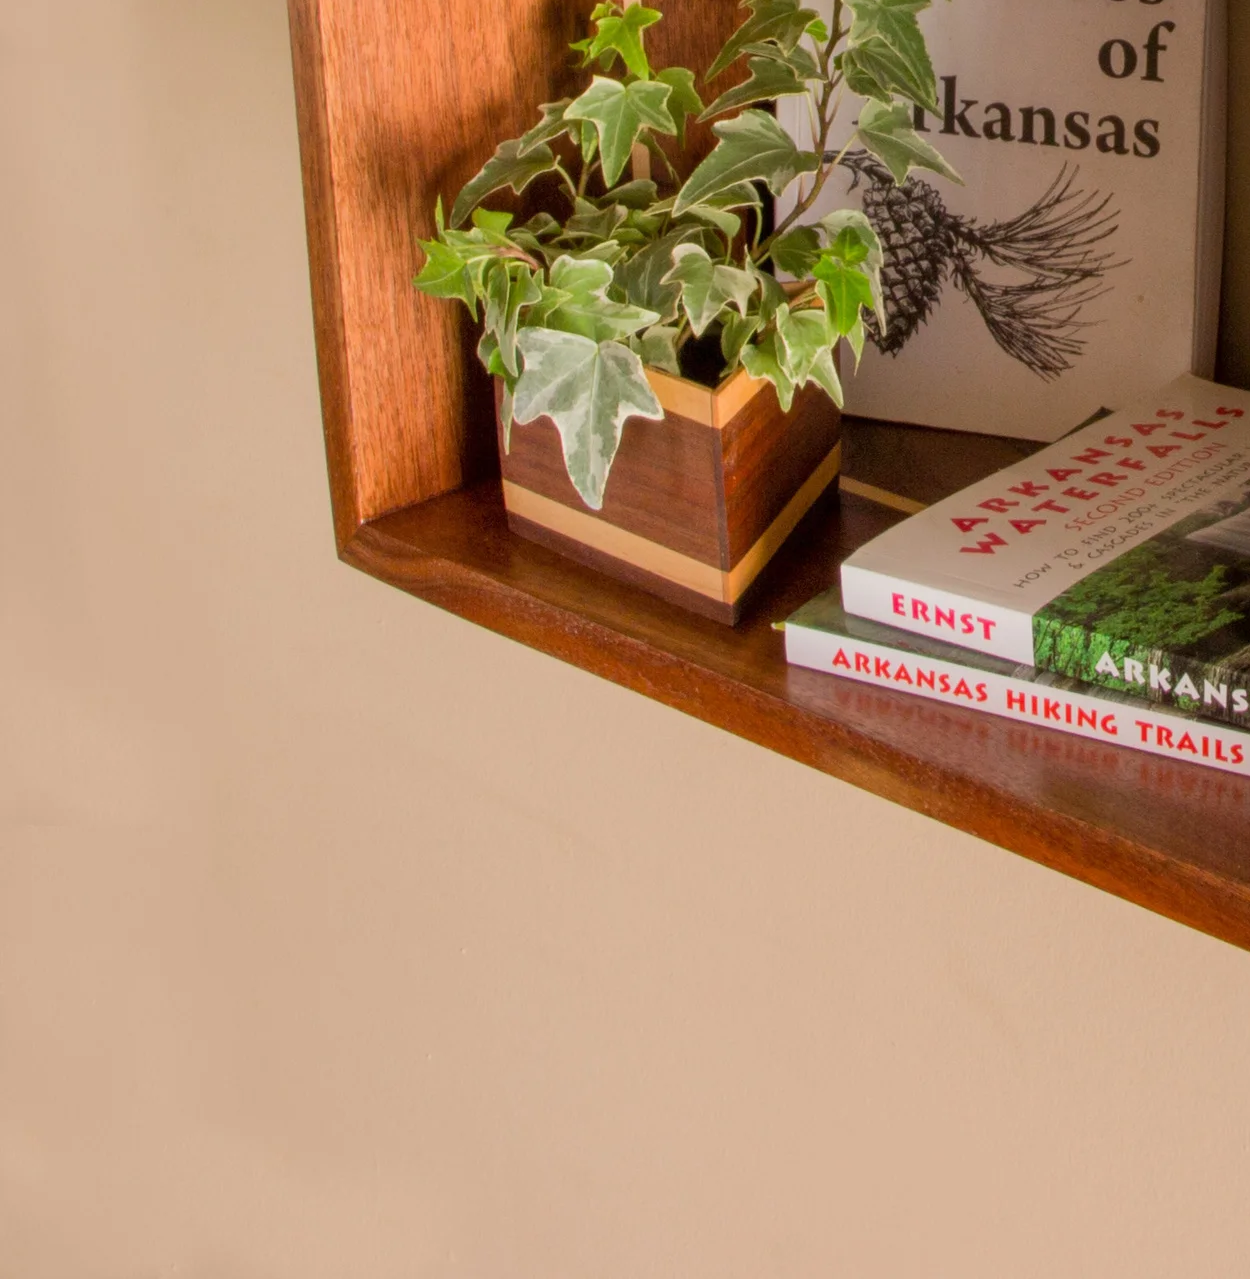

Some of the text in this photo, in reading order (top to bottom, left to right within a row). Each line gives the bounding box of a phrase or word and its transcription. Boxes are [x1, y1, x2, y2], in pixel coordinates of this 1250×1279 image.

[1098, 21, 1175, 83] of
[852, 74, 1161, 158] rkansas
[950, 408, 1184, 532] ARKANSAS
[959, 406, 1245, 554] WATERFALLS
[1064, 441, 1227, 532] SECOND EDITION
[1013, 562, 1052, 589] HOW
[1054, 547, 1079, 561] TO
[1081, 525, 1117, 546] FIND
[1118, 503, 1158, 524] 200+
[1160, 451, 1243, 501] SPECTACULAR
[1067, 561, 1086, 570] &
[1087, 520, 1154, 560] CASCADES
[1154, 506, 1176, 519] IN
[892, 591, 997, 641] ERNST
[831, 647, 988, 703] ARKANSAS
[1006, 688, 1119, 737] HIKING
[1134, 719, 1245, 765] TRAILS
